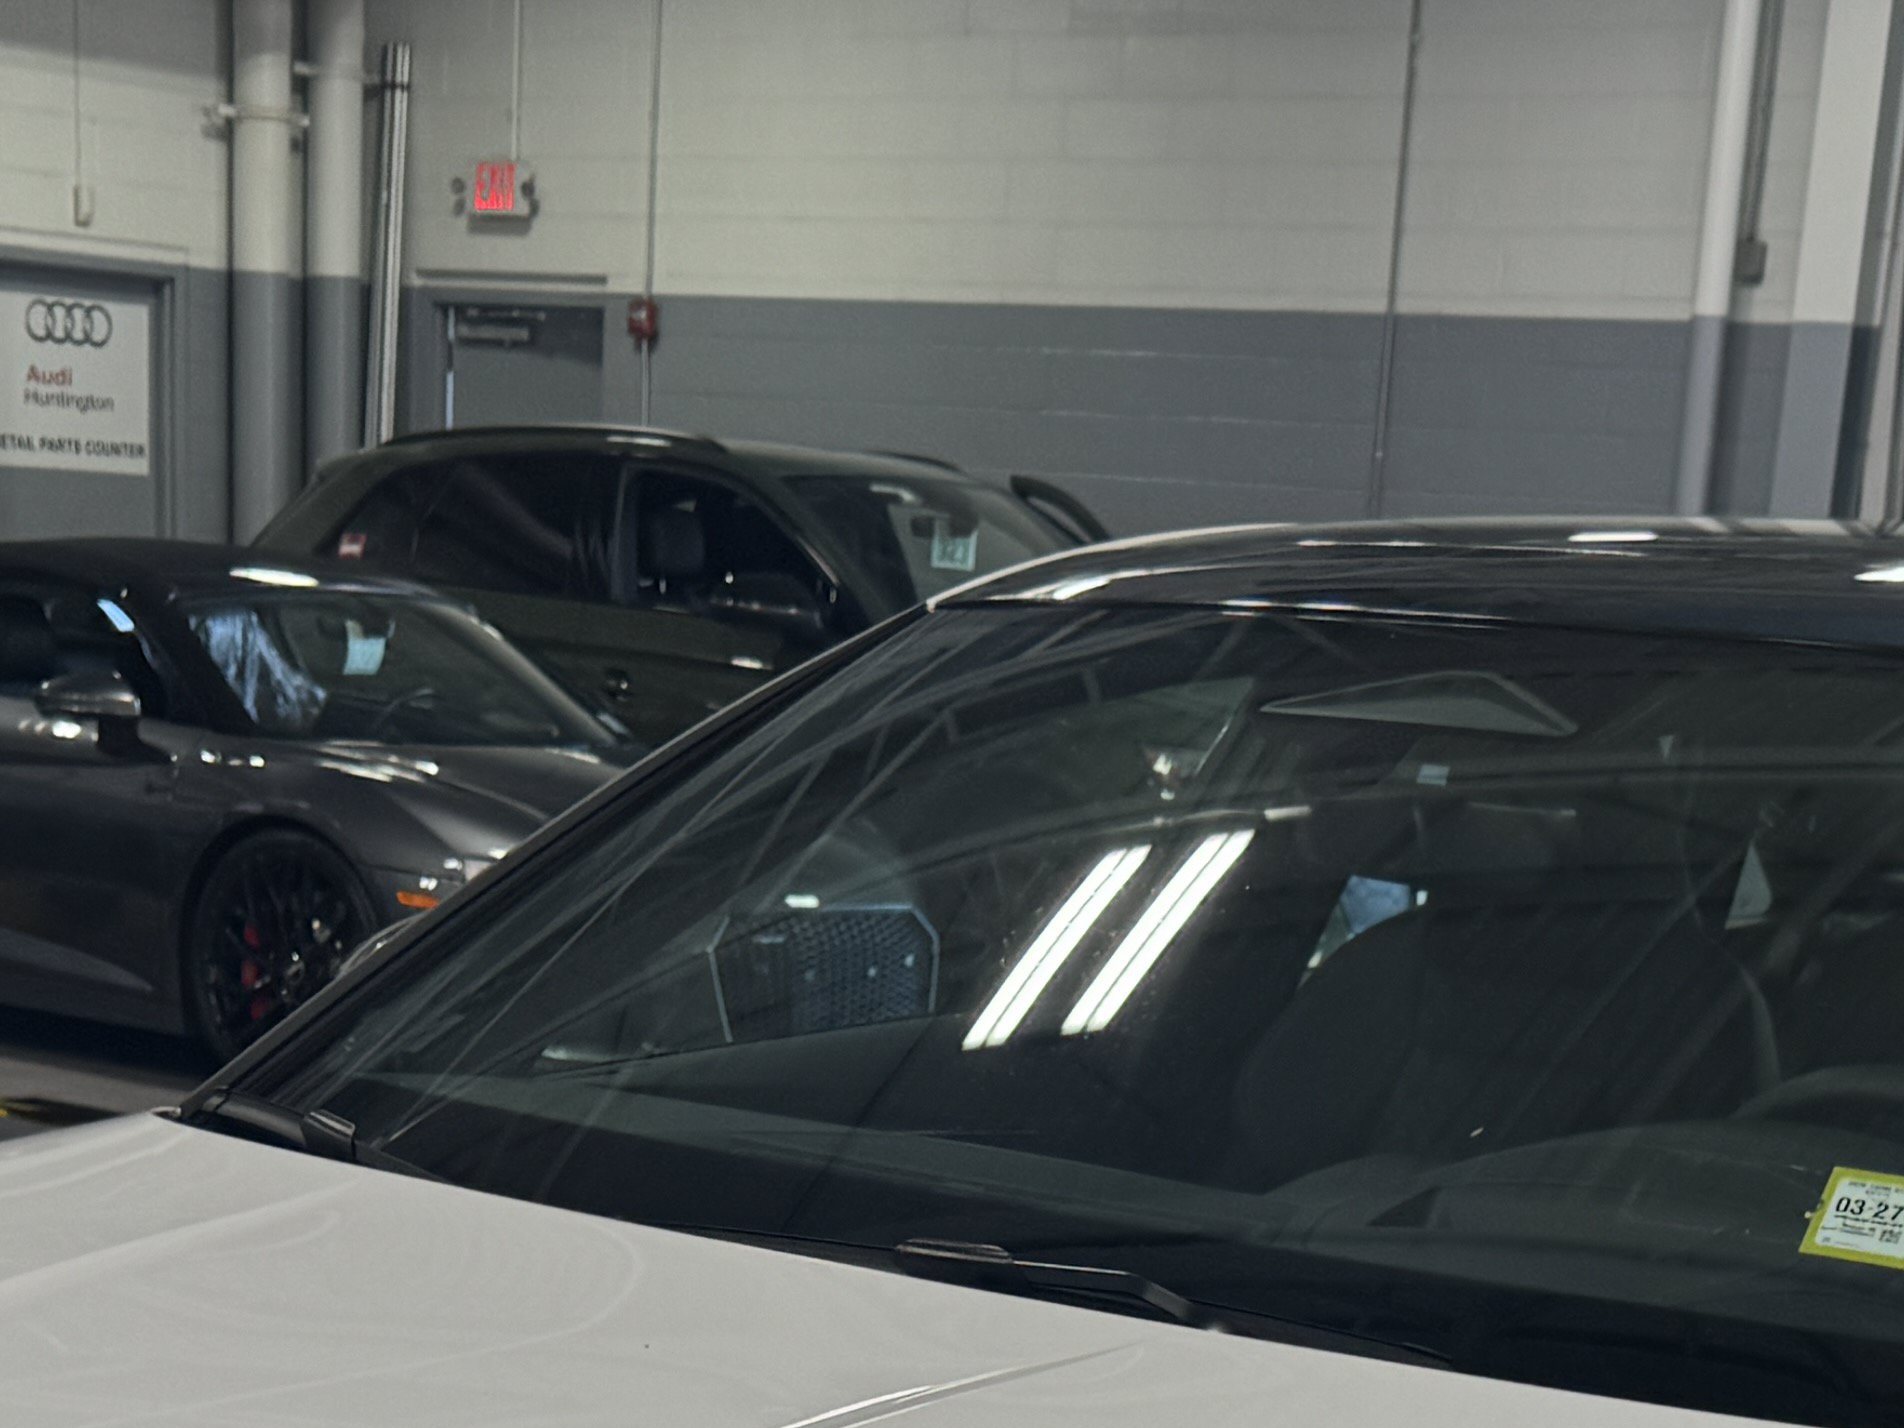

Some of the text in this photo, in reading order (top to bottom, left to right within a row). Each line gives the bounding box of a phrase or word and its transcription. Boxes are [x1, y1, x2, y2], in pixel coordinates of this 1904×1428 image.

[474, 161, 515, 210] EXIT
[26, 363, 73, 387] Audi
[23, 387, 115, 415] Huntington
[39, 436, 81, 456] PARTS
[84, 439, 146, 459] COUNTER
